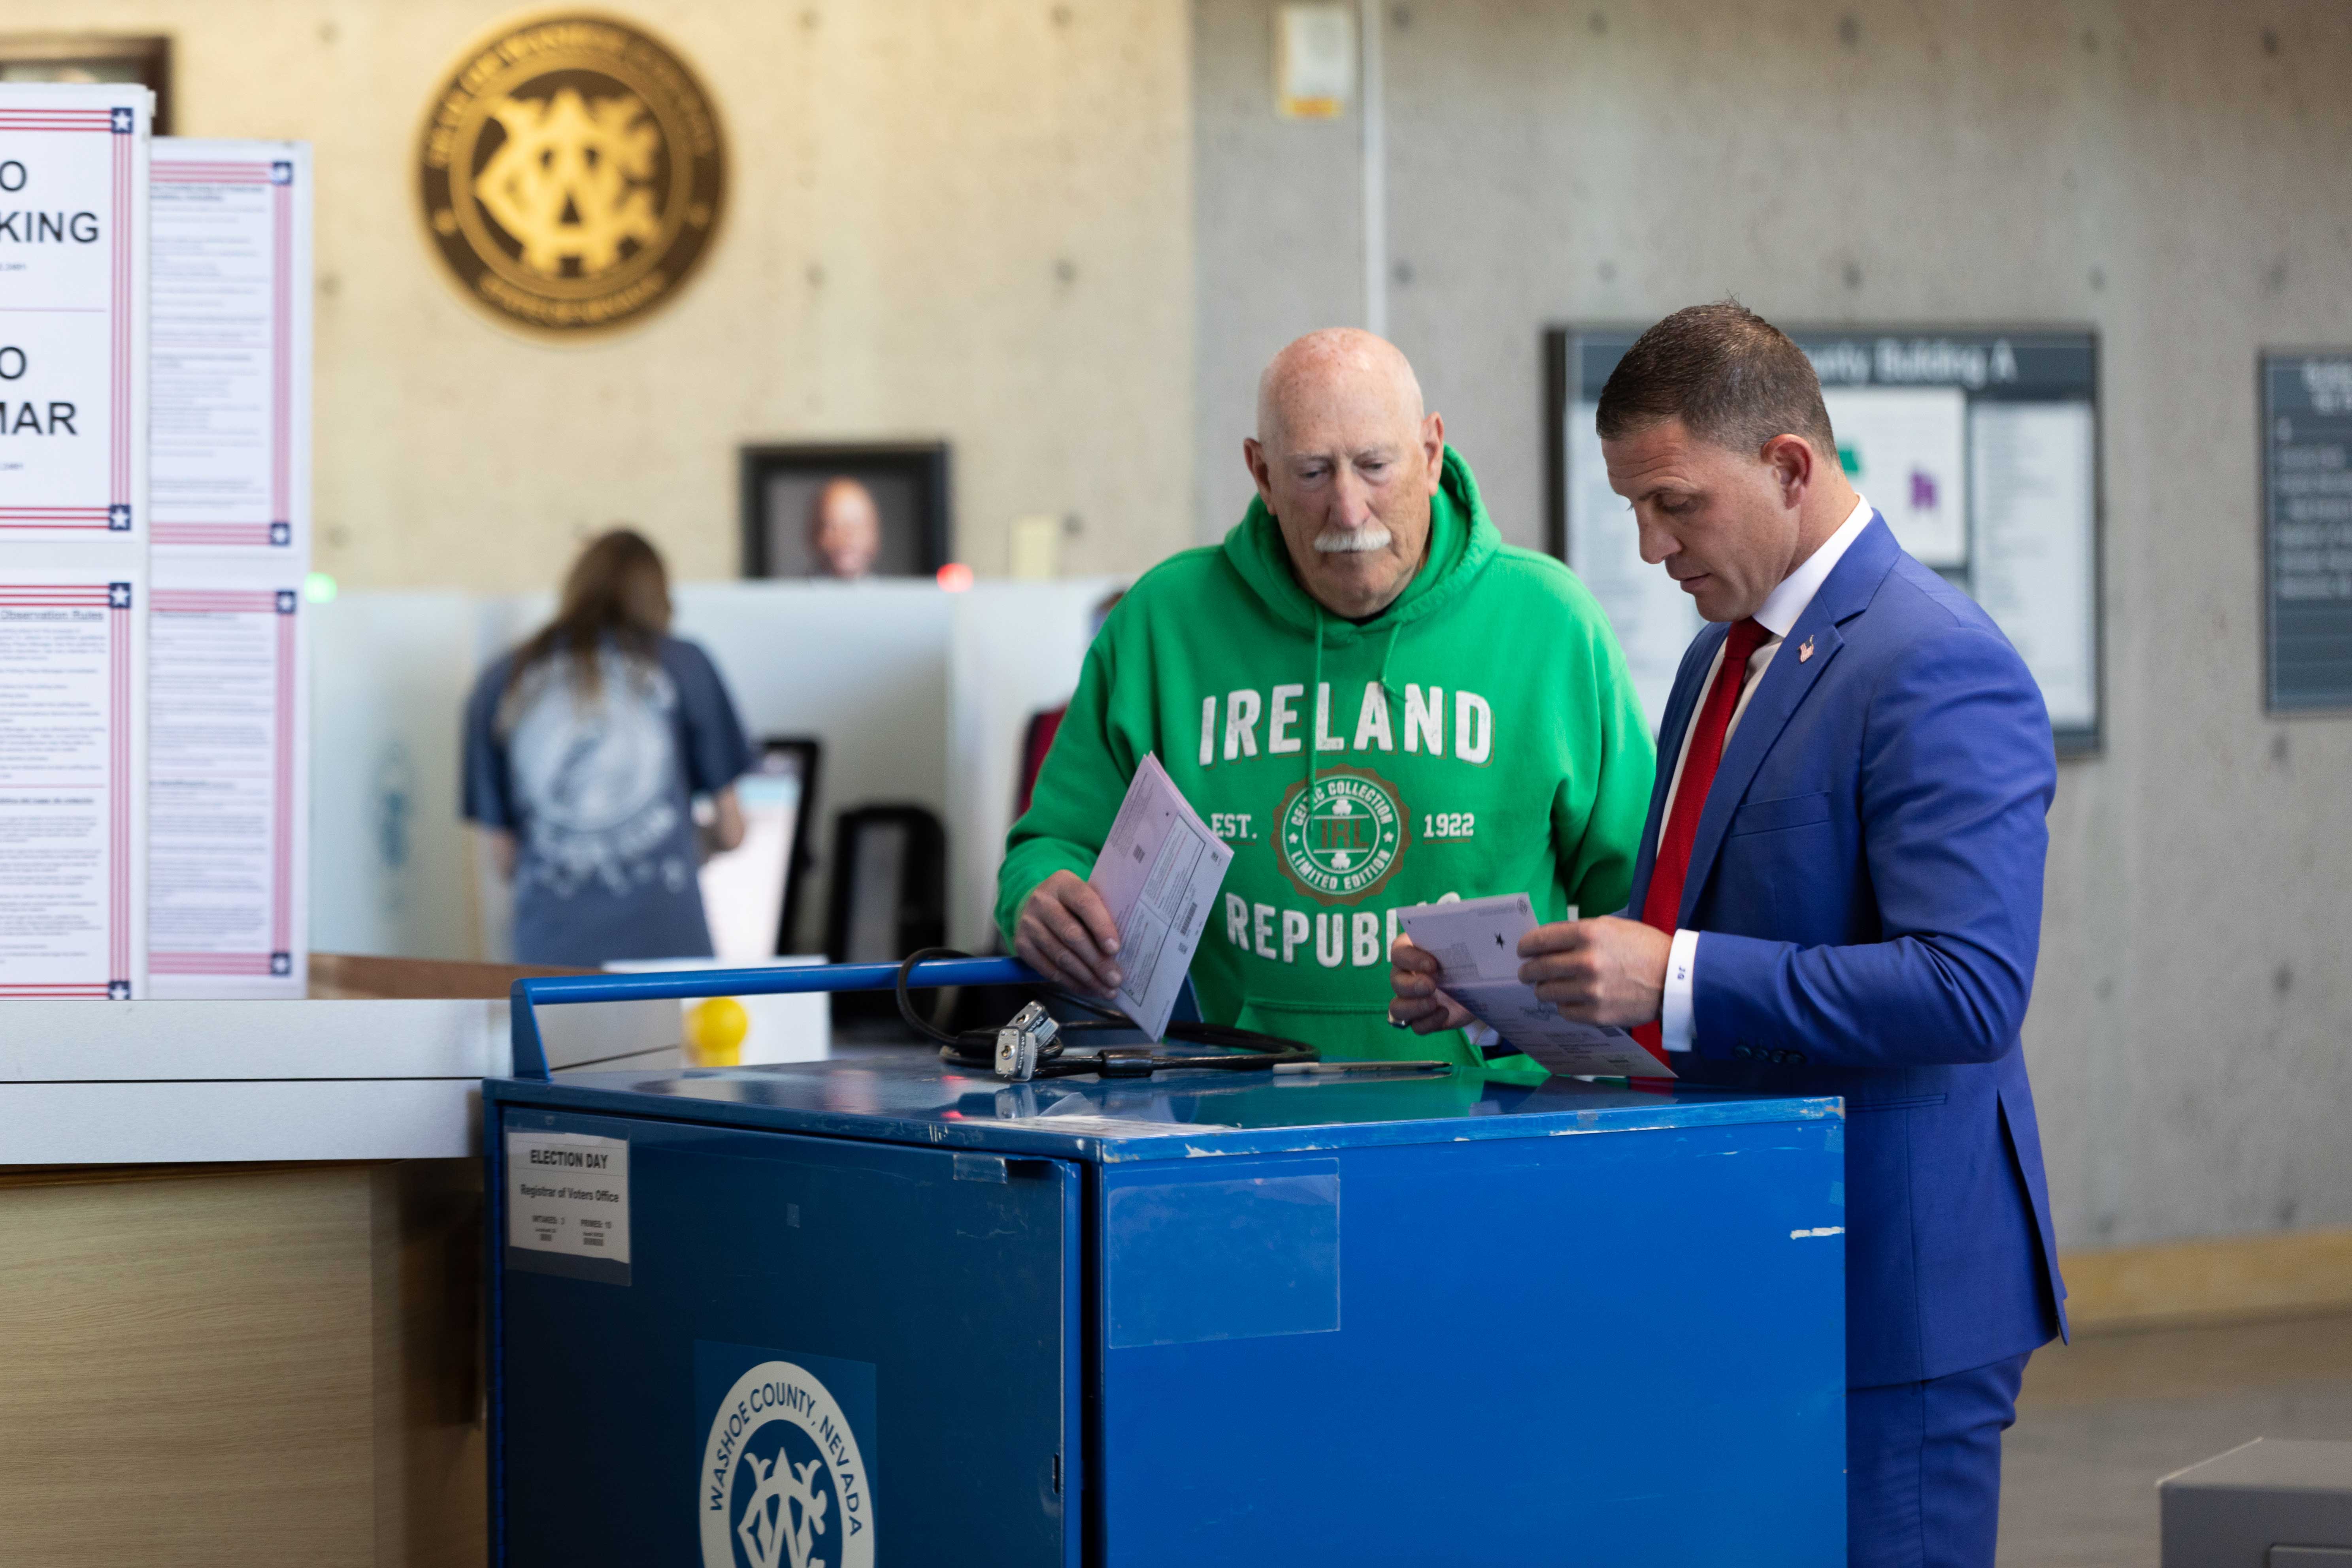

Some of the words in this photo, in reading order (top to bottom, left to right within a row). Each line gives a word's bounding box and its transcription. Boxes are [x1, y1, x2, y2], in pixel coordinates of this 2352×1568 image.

[0, 402, 77, 435] AR
[1199, 682, 1493, 767] IRELAND
[1328, 781, 1394, 825] COLLECTION
[1211, 813, 1257, 839] EST.
[1322, 819, 1369, 848] IRL
[1424, 813, 1475, 837] 1922
[1290, 850, 1338, 891] LIMITED
[1343, 849, 1391, 890] EDITION
[531, 1149, 583, 1167] ELECTION
[587, 1153, 608, 1169] DAY
[521, 1184, 555, 1198] Registrar
[558, 1187, 566, 1198] of
[567, 1188, 593, 1200] Voters
[595, 1190, 619, 1202] Office
[710, 1400, 750, 1511] WASHOE
[751, 1382, 816, 1426] COUNTY,
[819, 1415, 863, 1537] NEVADA
